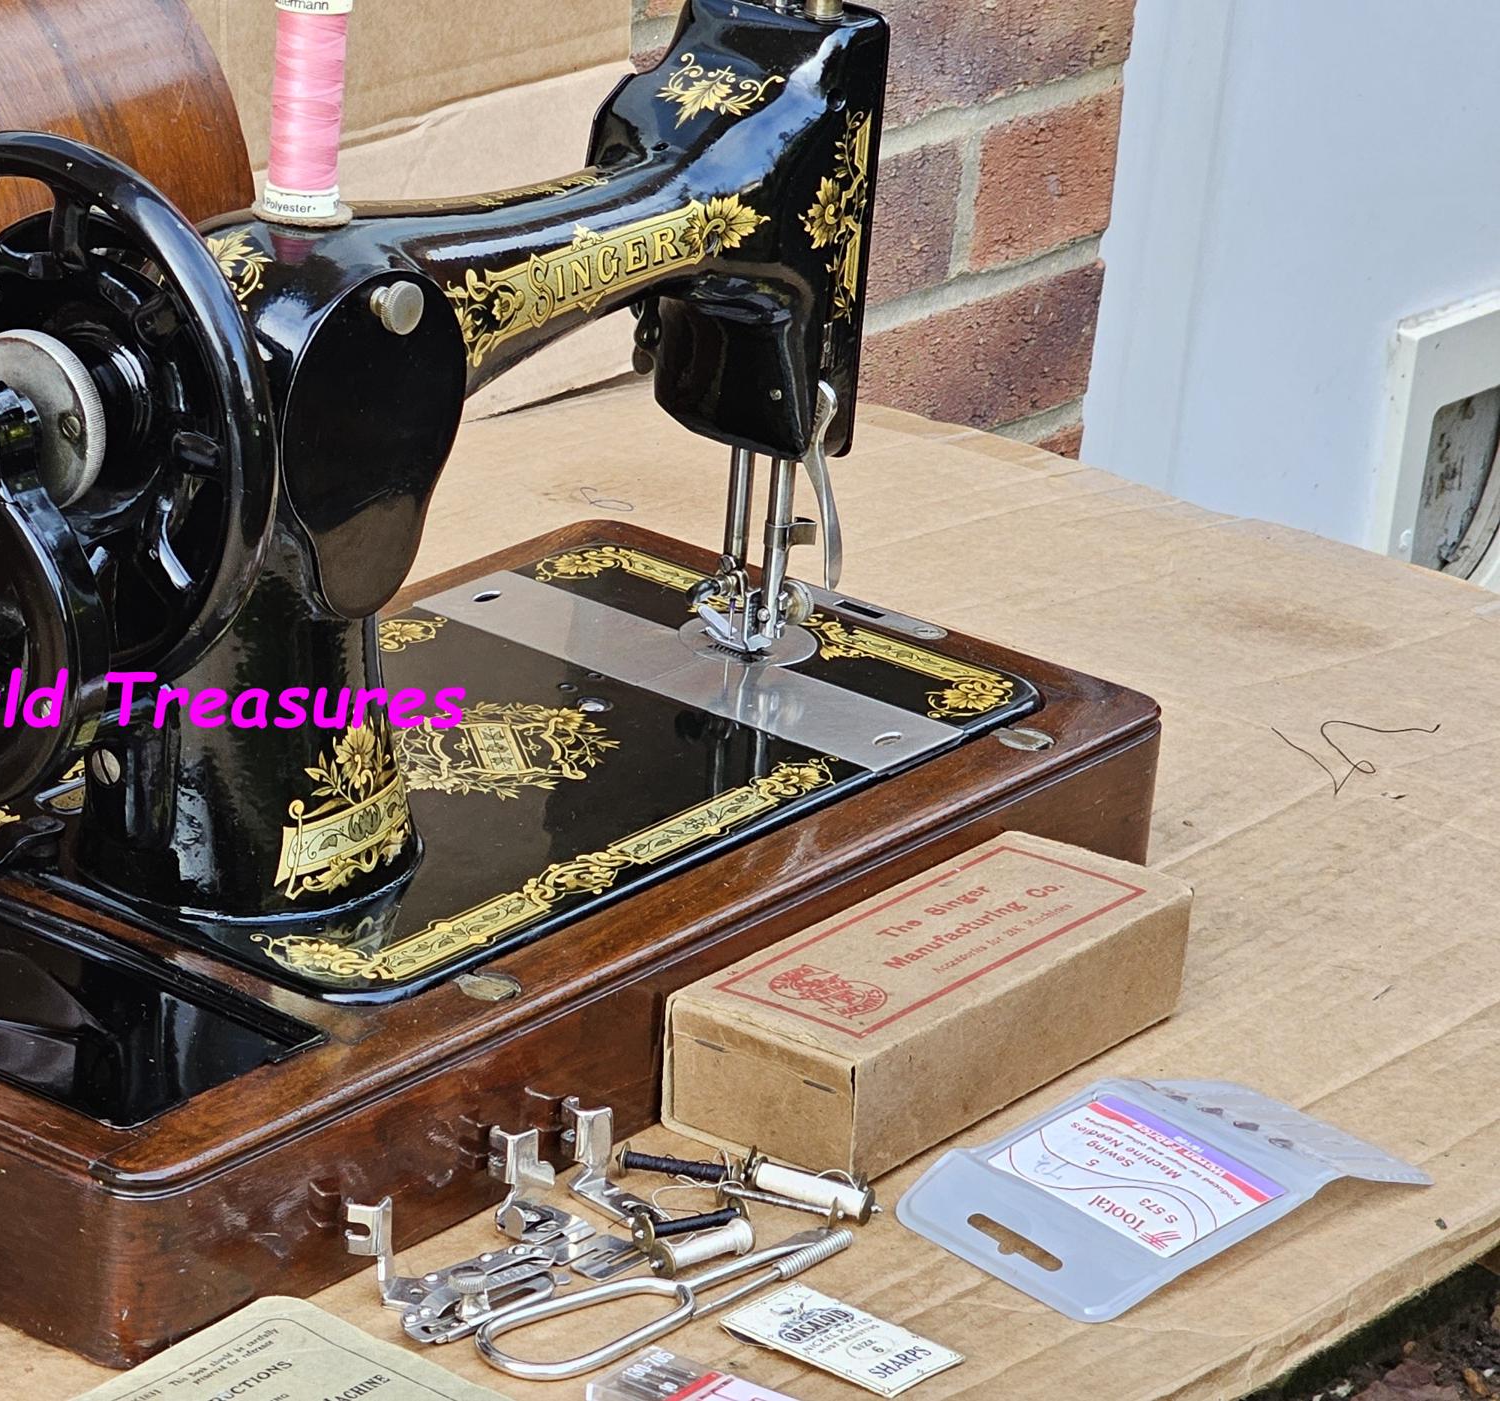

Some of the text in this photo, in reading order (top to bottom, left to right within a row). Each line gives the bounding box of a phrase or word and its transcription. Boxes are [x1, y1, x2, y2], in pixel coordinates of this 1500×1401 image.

[528, 226, 685, 328] SINGER
[876, 885, 992, 938] The Singer
[882, 883, 1066, 969] Manufacturing Co.
[1070, 1121, 1182, 1179] Machine Needles
[1085, 1157, 1100, 1167] 5
[1086, 1139, 1135, 1168] Sewing
[1088, 1195, 1145, 1232] Tootal
[1139, 1198, 1178, 1224] S 573
[802, 1333, 840, 1352] NICKEL
[837, 1317, 873, 1334] PLATED
[868, 1345, 932, 1379] SHARPS
[324, 1374, 390, 1401] ACHINE
